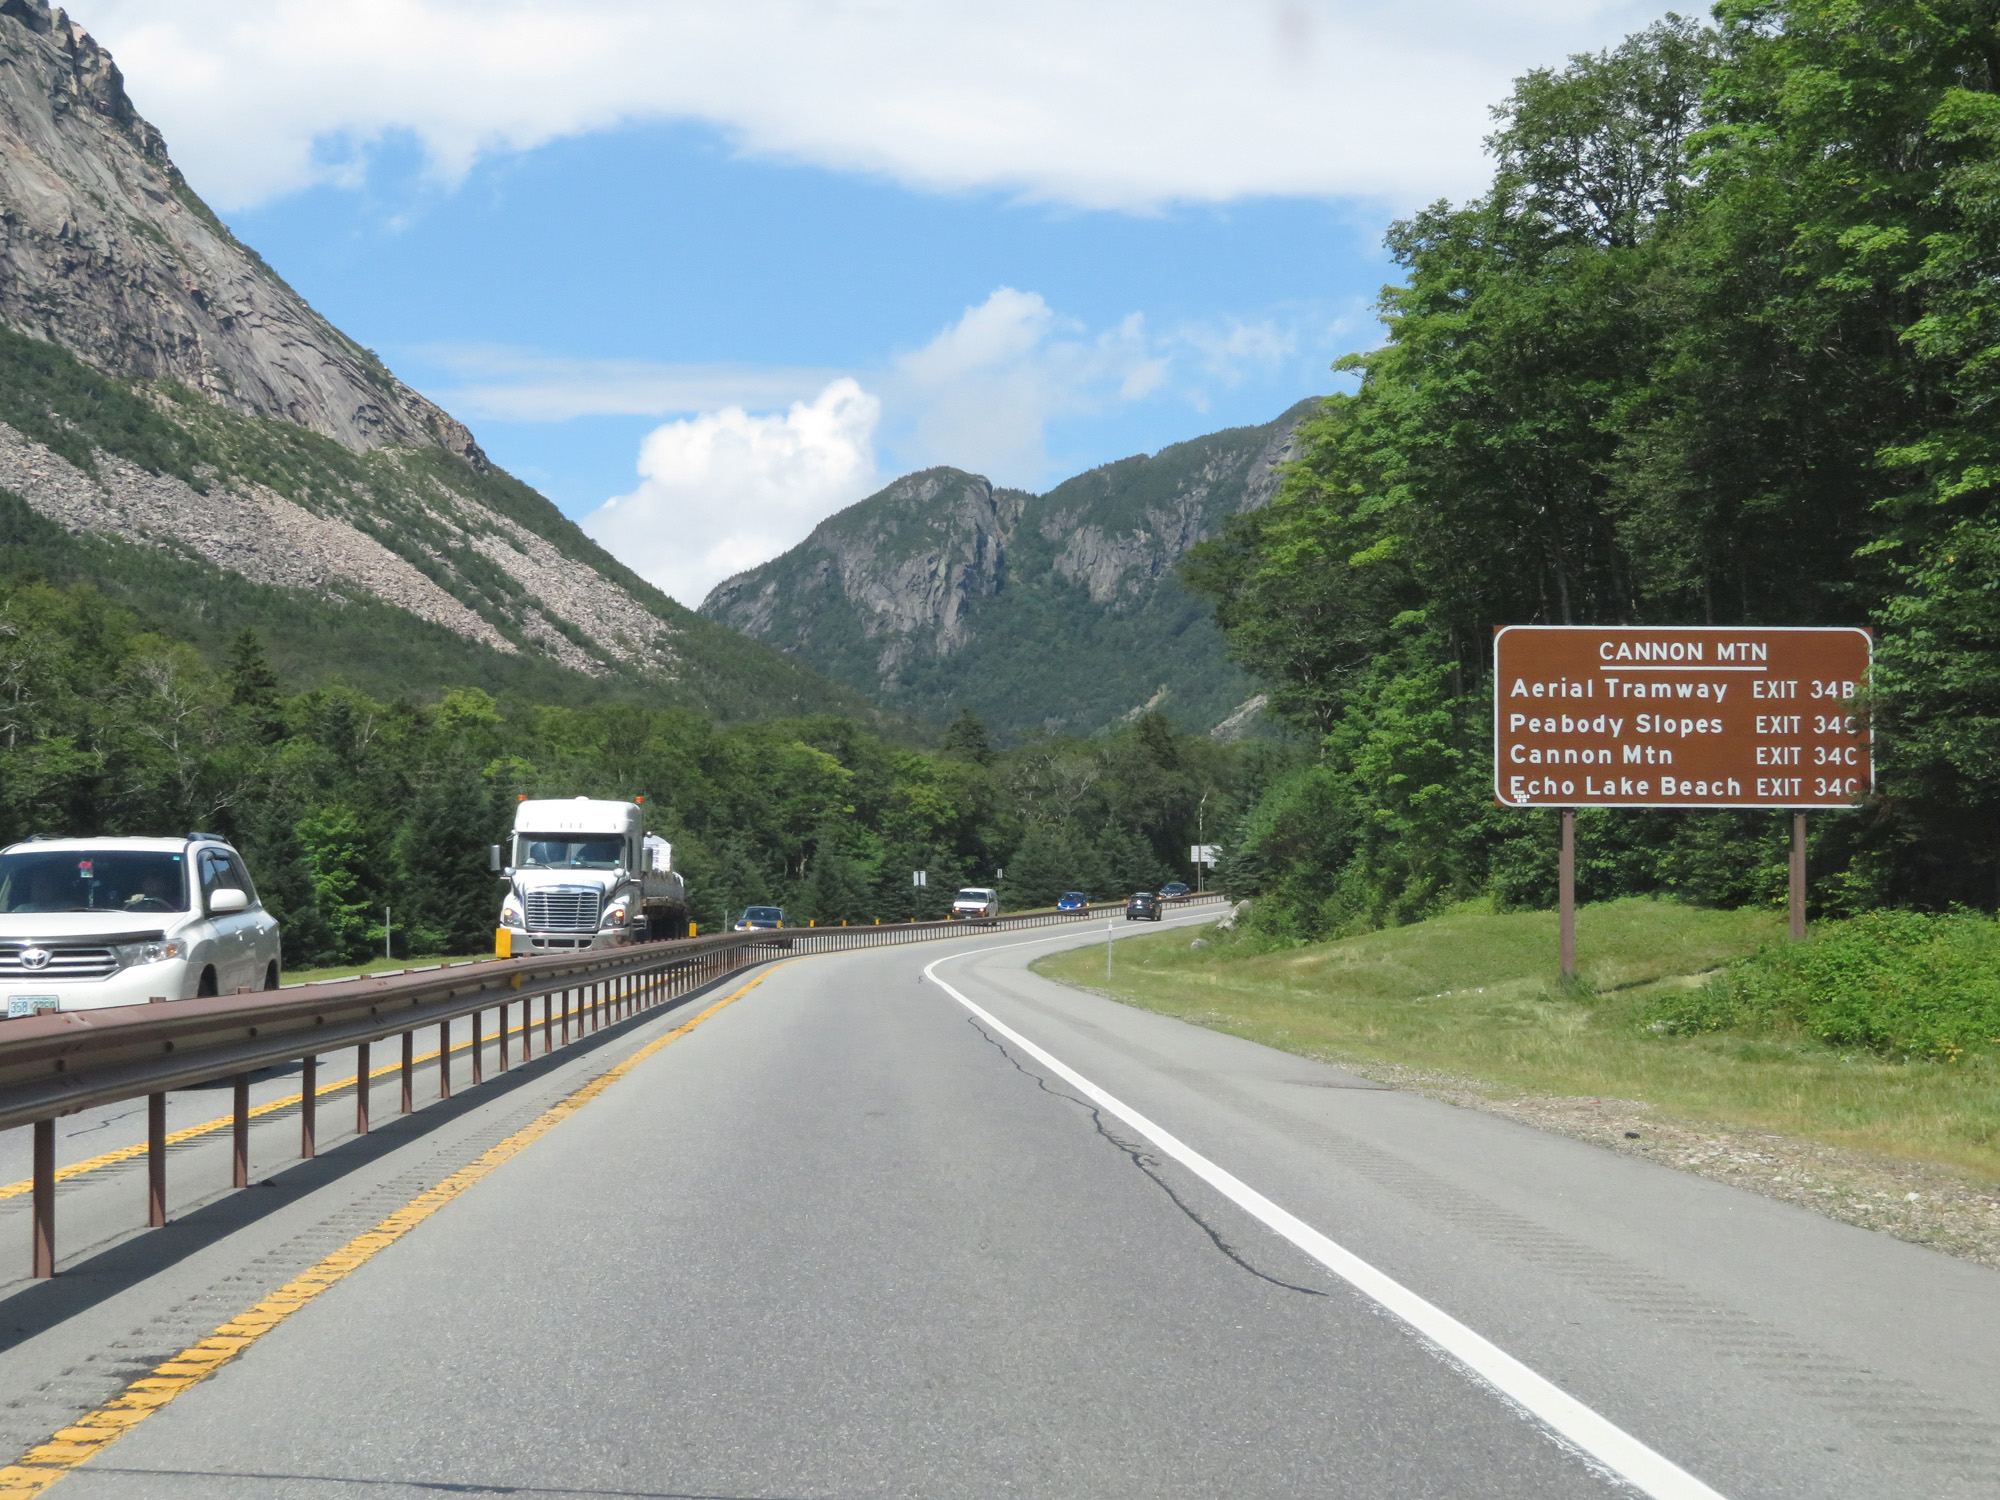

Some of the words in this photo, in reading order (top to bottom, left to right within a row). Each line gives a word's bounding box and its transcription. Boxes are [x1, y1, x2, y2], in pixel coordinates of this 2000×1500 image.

[1599, 641, 1703, 661] CANNON
[1717, 641, 1767, 661] MTN
[1510, 676, 1593, 698] Aerial
[1604, 678, 1728, 704] Tramway
[1753, 680, 1798, 699] EXIT
[1810, 680, 1855, 699] 34B
[1510, 712, 1624, 738] Peabody
[1635, 712, 1723, 739] Slopes
[1756, 715, 1801, 734] EXIT
[1510, 743, 1612, 765] Cannon
[1622, 744, 1673, 765] Mtn
[1756, 746, 1801, 765] EXIT
[1813, 746, 1858, 765] 34C
[1510, 775, 1575, 796] Echo
[1586, 775, 1650, 796] Lake
[1660, 775, 1741, 796] Beach
[1757, 777, 1802, 796] EXIT
[1814, 777, 1858, 797] 34C
[10, 1001, 28, 1013] 358
